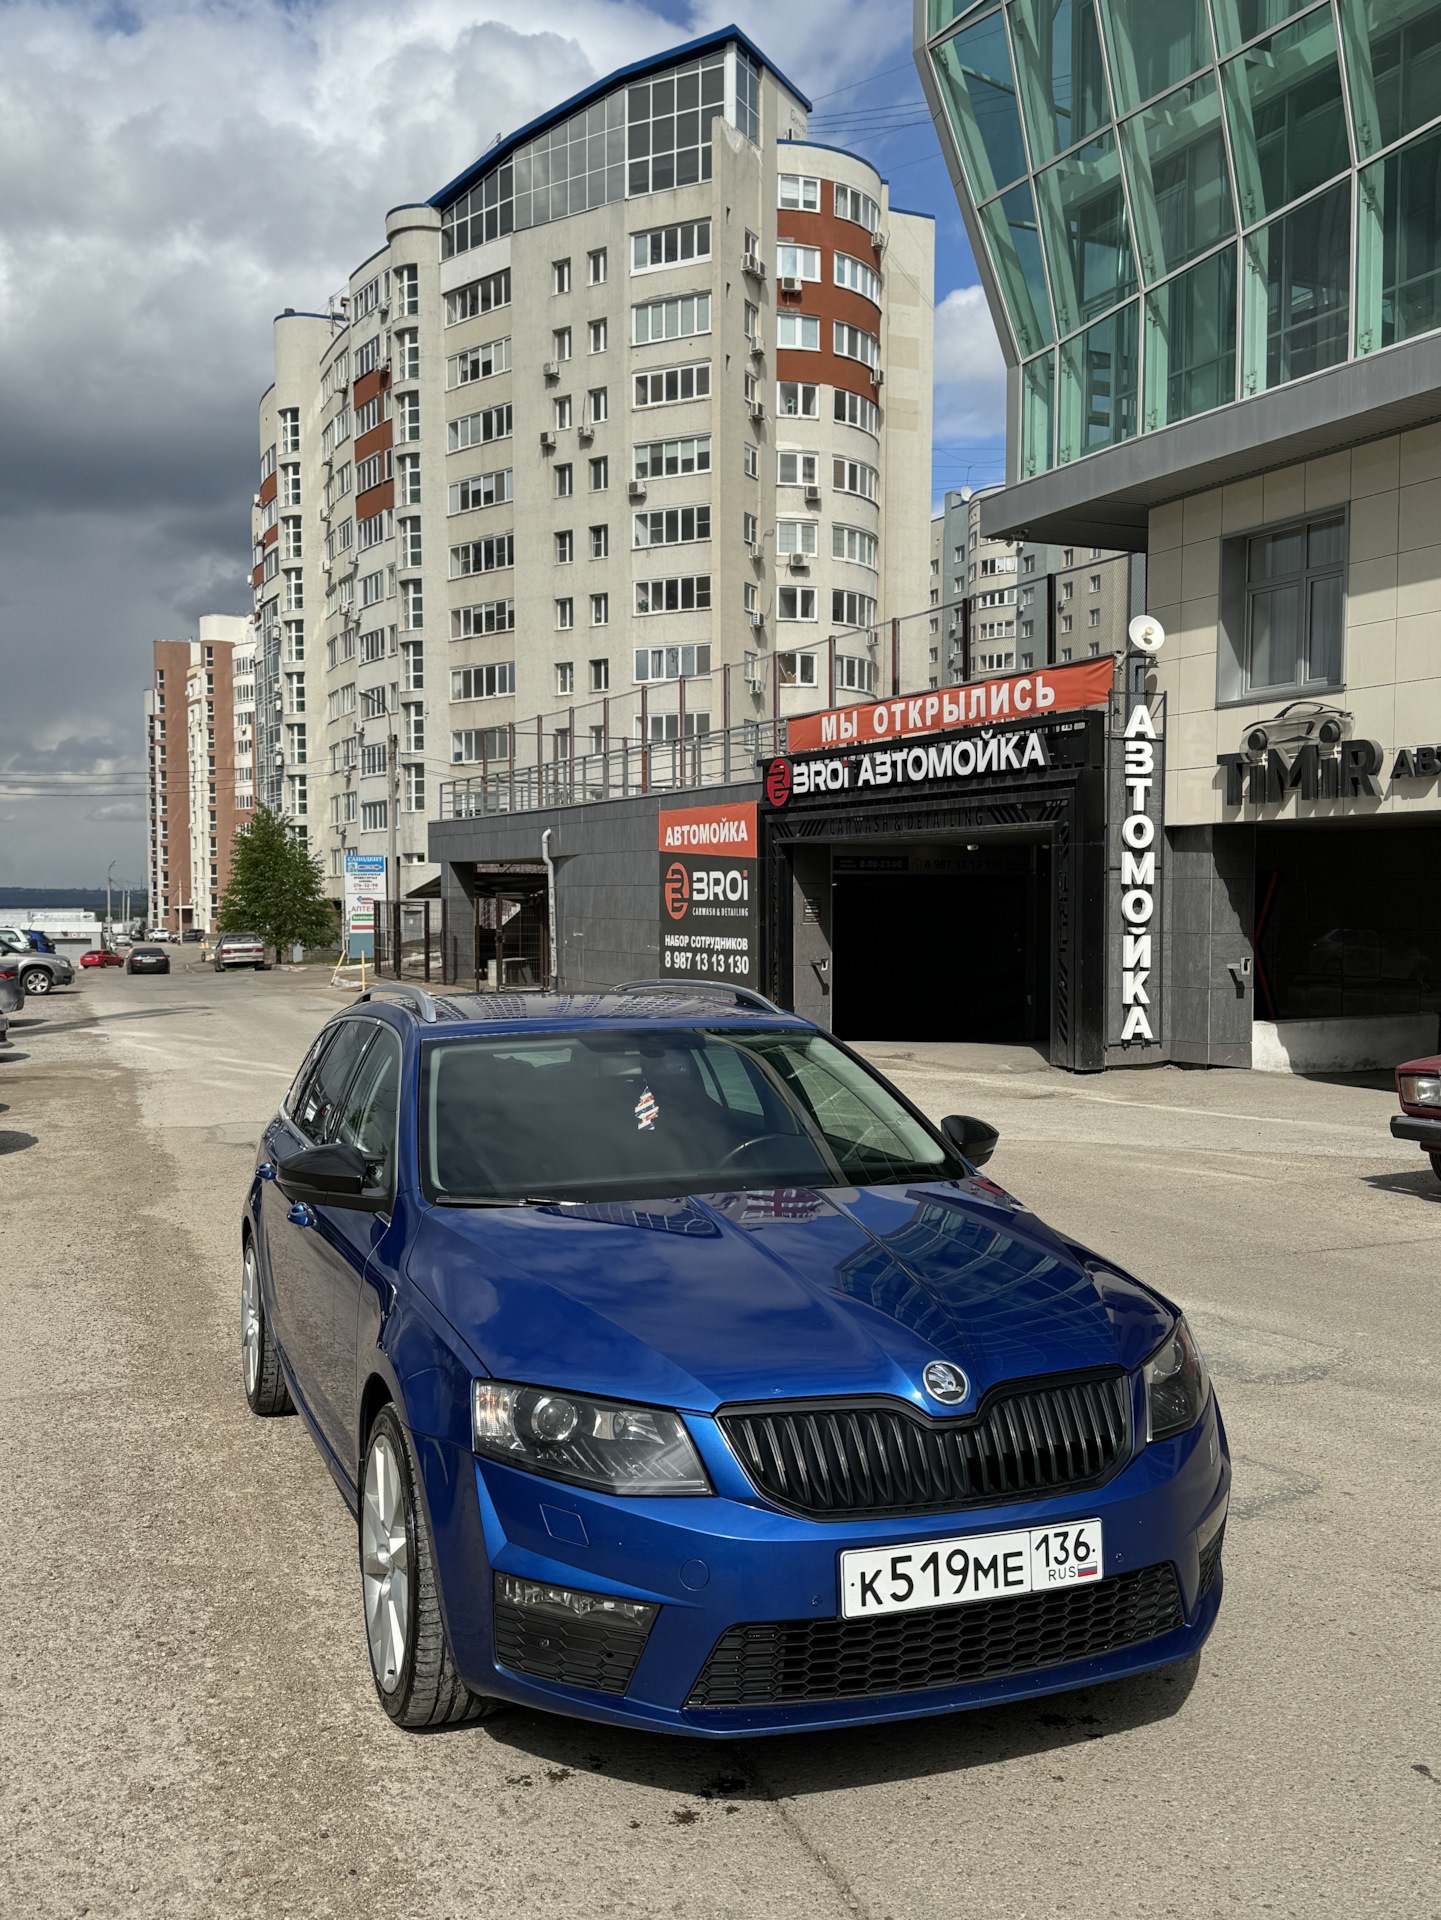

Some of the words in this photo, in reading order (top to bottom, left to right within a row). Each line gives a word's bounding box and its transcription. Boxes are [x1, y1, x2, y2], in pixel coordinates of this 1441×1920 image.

[821, 711, 858, 743] МЫ
[873, 676, 1056, 734] ОТКРЫЛИСЬ
[857, 730, 1047, 787] АВТОМОЙКА
[1390, 746, 1441, 780] АВ
[665, 817, 748, 847] АВТОМОЙКА
[829, 816, 889, 836] CARWASH
[894, 815, 902, 831] &
[907, 807, 984, 830] DETAILING
[1121, 704, 1157, 1040] АВТОМОЙКА
[721, 907, 749, 917] DETAILING
[665, 934, 690, 948] НАБОР
[690, 935, 749, 952] СОТРУДНИКОВ
[665, 951, 671, 969] 8
[673, 952, 693, 970] 987
[695, 953, 709, 972] 13
[711, 953, 725, 973] 13
[728, 955, 750, 975] 130
[860, 1548, 1024, 1607] К519МЕ
[1035, 1528, 1092, 1568] 136
[1048, 1566, 1077, 1582] RUS
